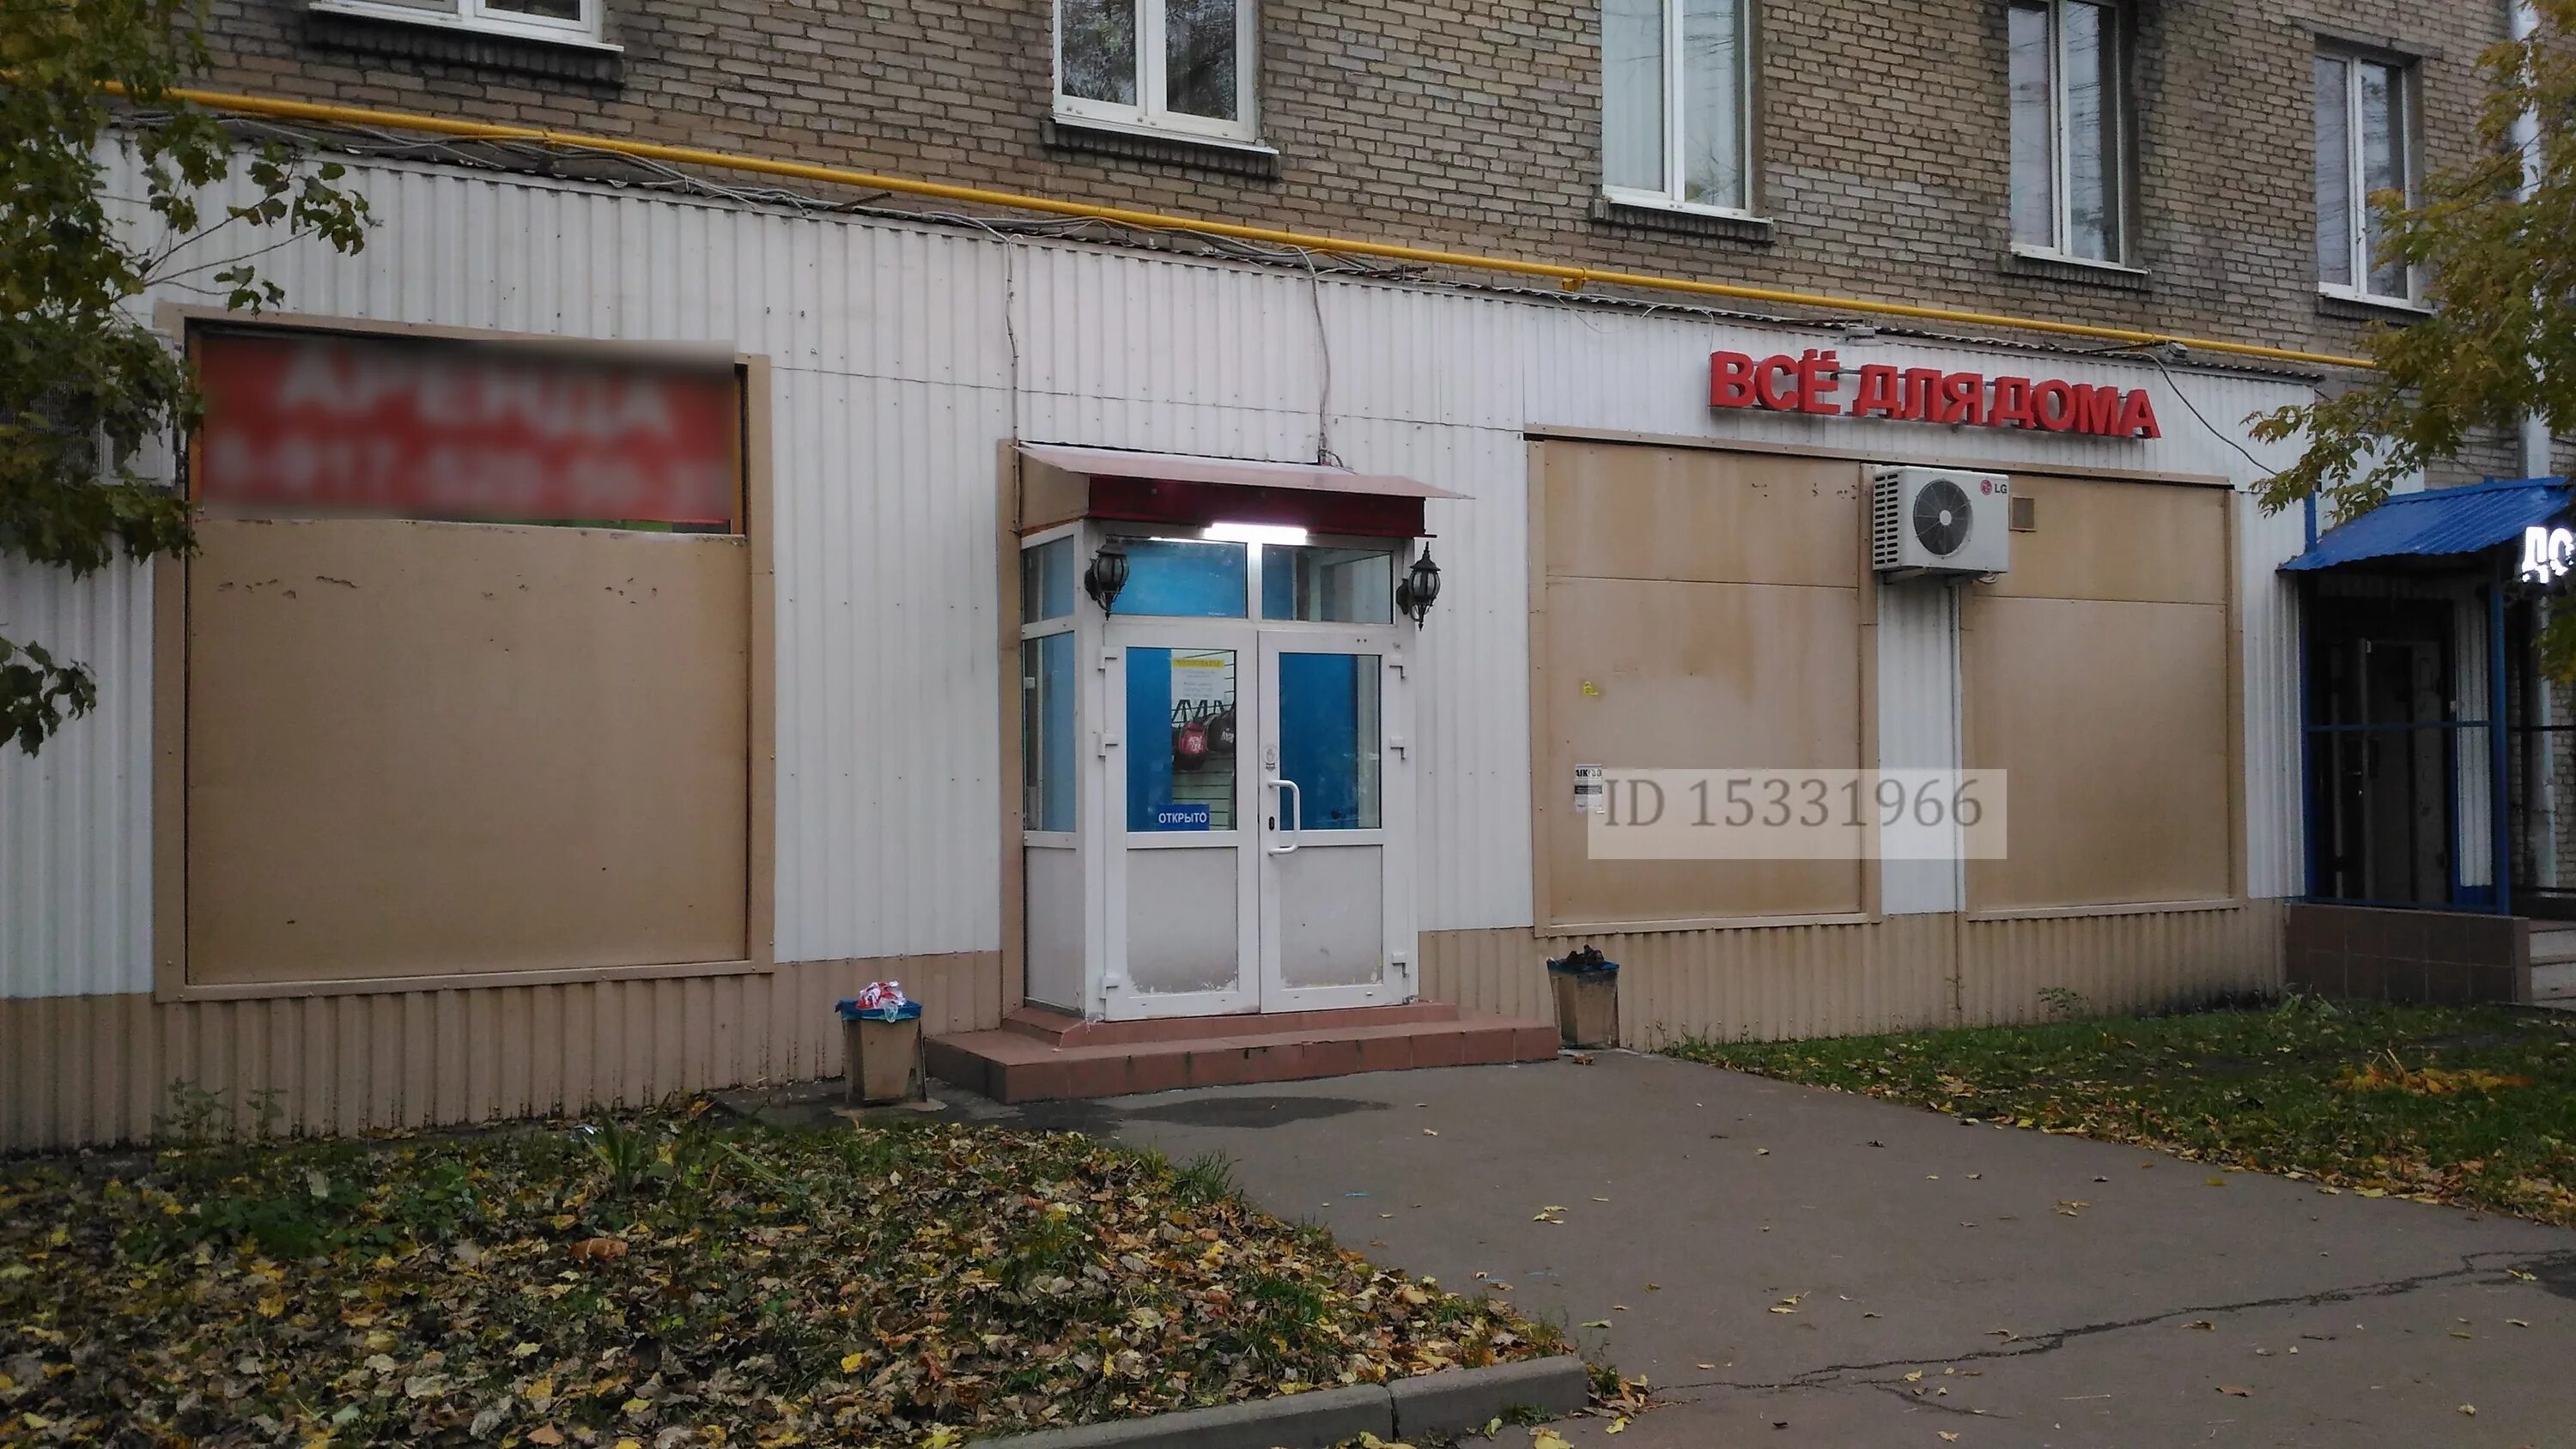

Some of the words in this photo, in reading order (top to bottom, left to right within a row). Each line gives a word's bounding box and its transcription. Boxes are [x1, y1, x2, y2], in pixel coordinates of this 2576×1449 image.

[1710, 349, 1841, 415] ВСЁ
[1852, 364, 1984, 426] ДЛЯ
[1988, 376, 2161, 439] ДОМА
[1994, 483, 2008, 494] LG
[1158, 812, 1207, 824] ОТКРЫТО
